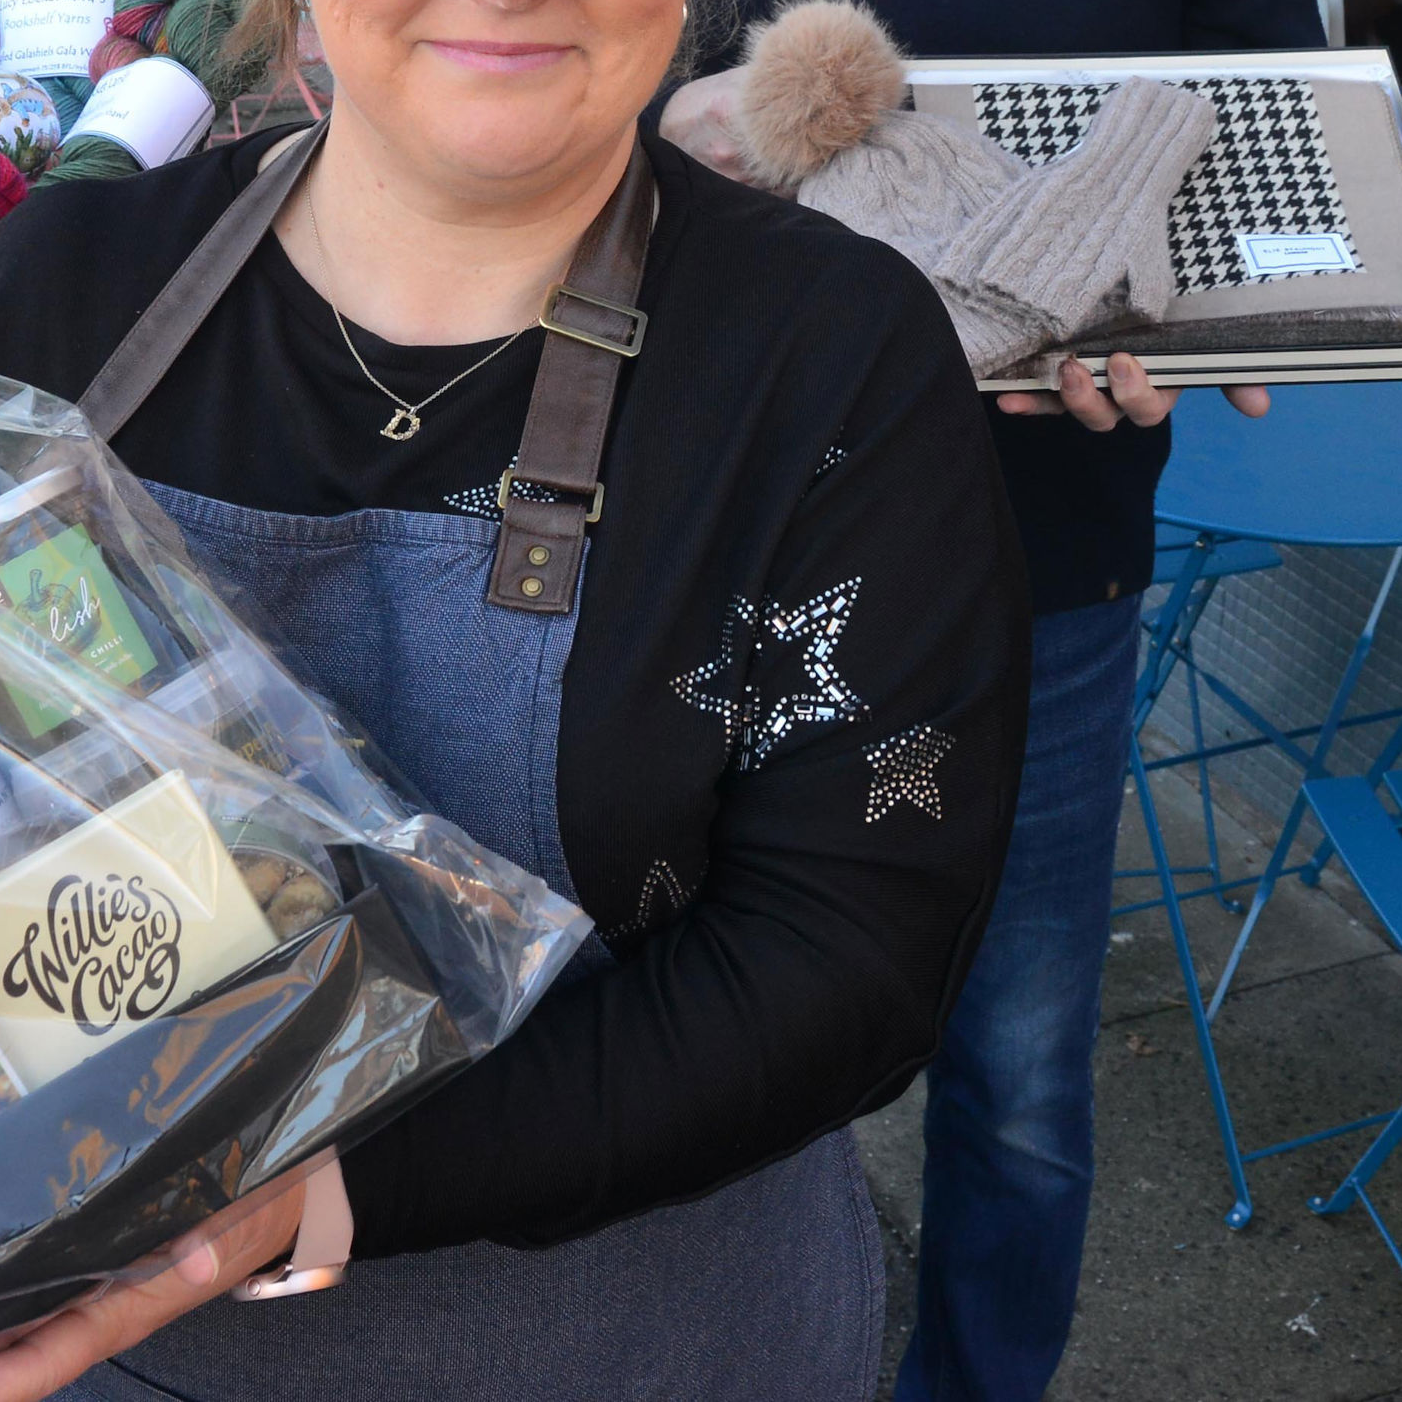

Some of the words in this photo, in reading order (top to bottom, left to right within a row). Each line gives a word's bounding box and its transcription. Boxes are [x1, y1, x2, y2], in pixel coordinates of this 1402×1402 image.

[3, 9, 55, 30] Bookshelf
[57, 12, 91, 25] Yarns
[90, 635, 124, 659] CHILLI
[72, 910, 171, 1036] Cacao
